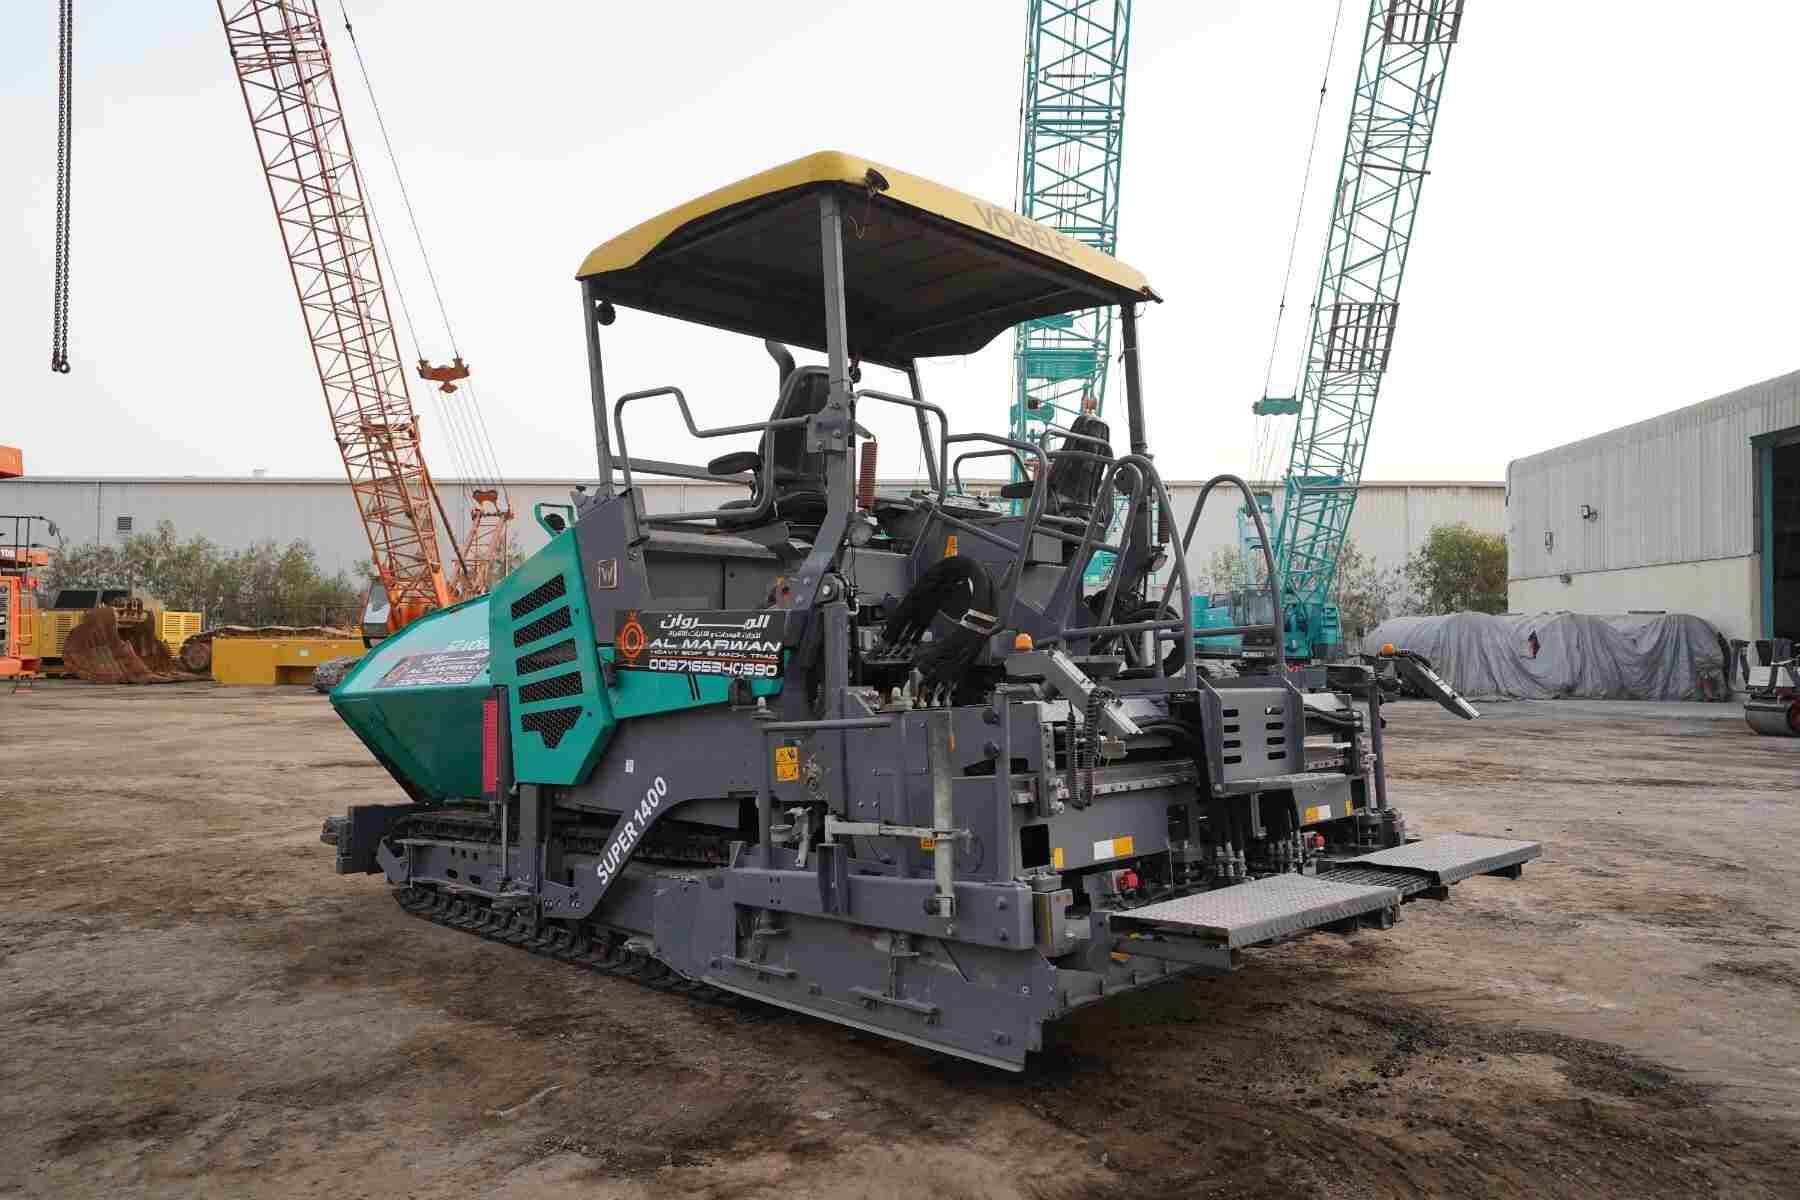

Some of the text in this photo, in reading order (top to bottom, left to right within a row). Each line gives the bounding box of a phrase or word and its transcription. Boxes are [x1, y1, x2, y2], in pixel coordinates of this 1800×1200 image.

[649, 638, 782, 652] AL MARWAN
[596, 775, 668, 885] SUPER 1400
